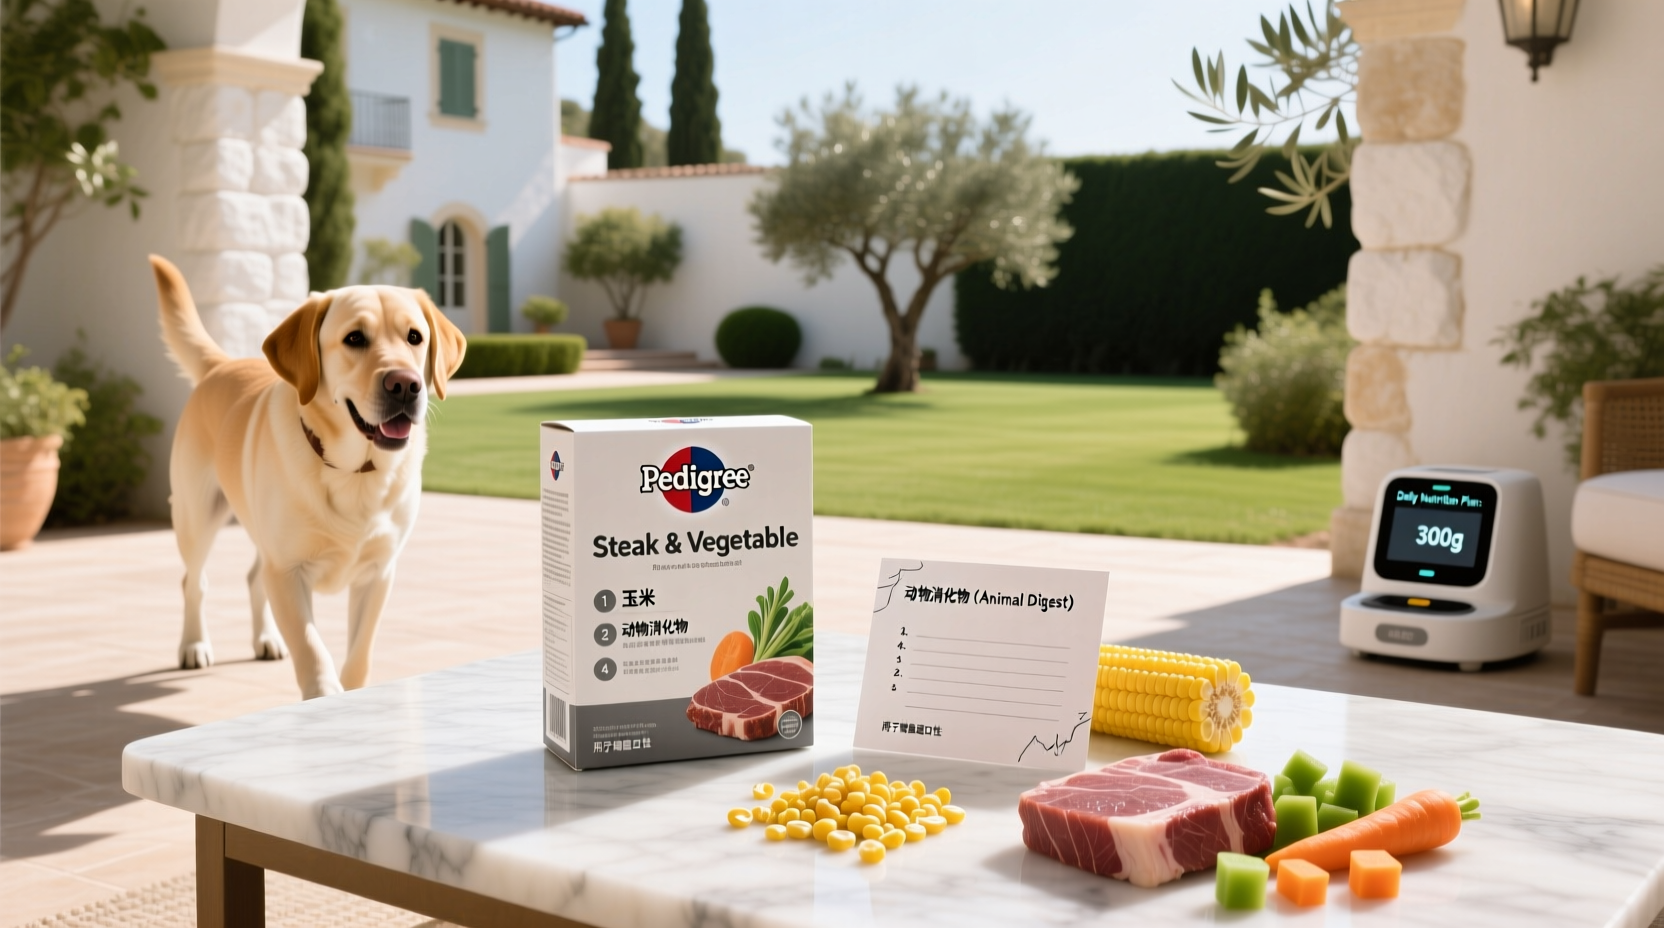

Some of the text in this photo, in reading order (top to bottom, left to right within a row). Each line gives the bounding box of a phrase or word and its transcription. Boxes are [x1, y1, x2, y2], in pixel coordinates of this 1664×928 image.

[640, 464, 751, 496] Pedigree
[593, 526, 799, 558] Steak & Vegetable
[1415, 524, 1464, 554] 300g
[622, 588, 655, 608] 玉米
[974, 589, 1024, 607] (Animal
[1027, 593, 1074, 612] Digest)
